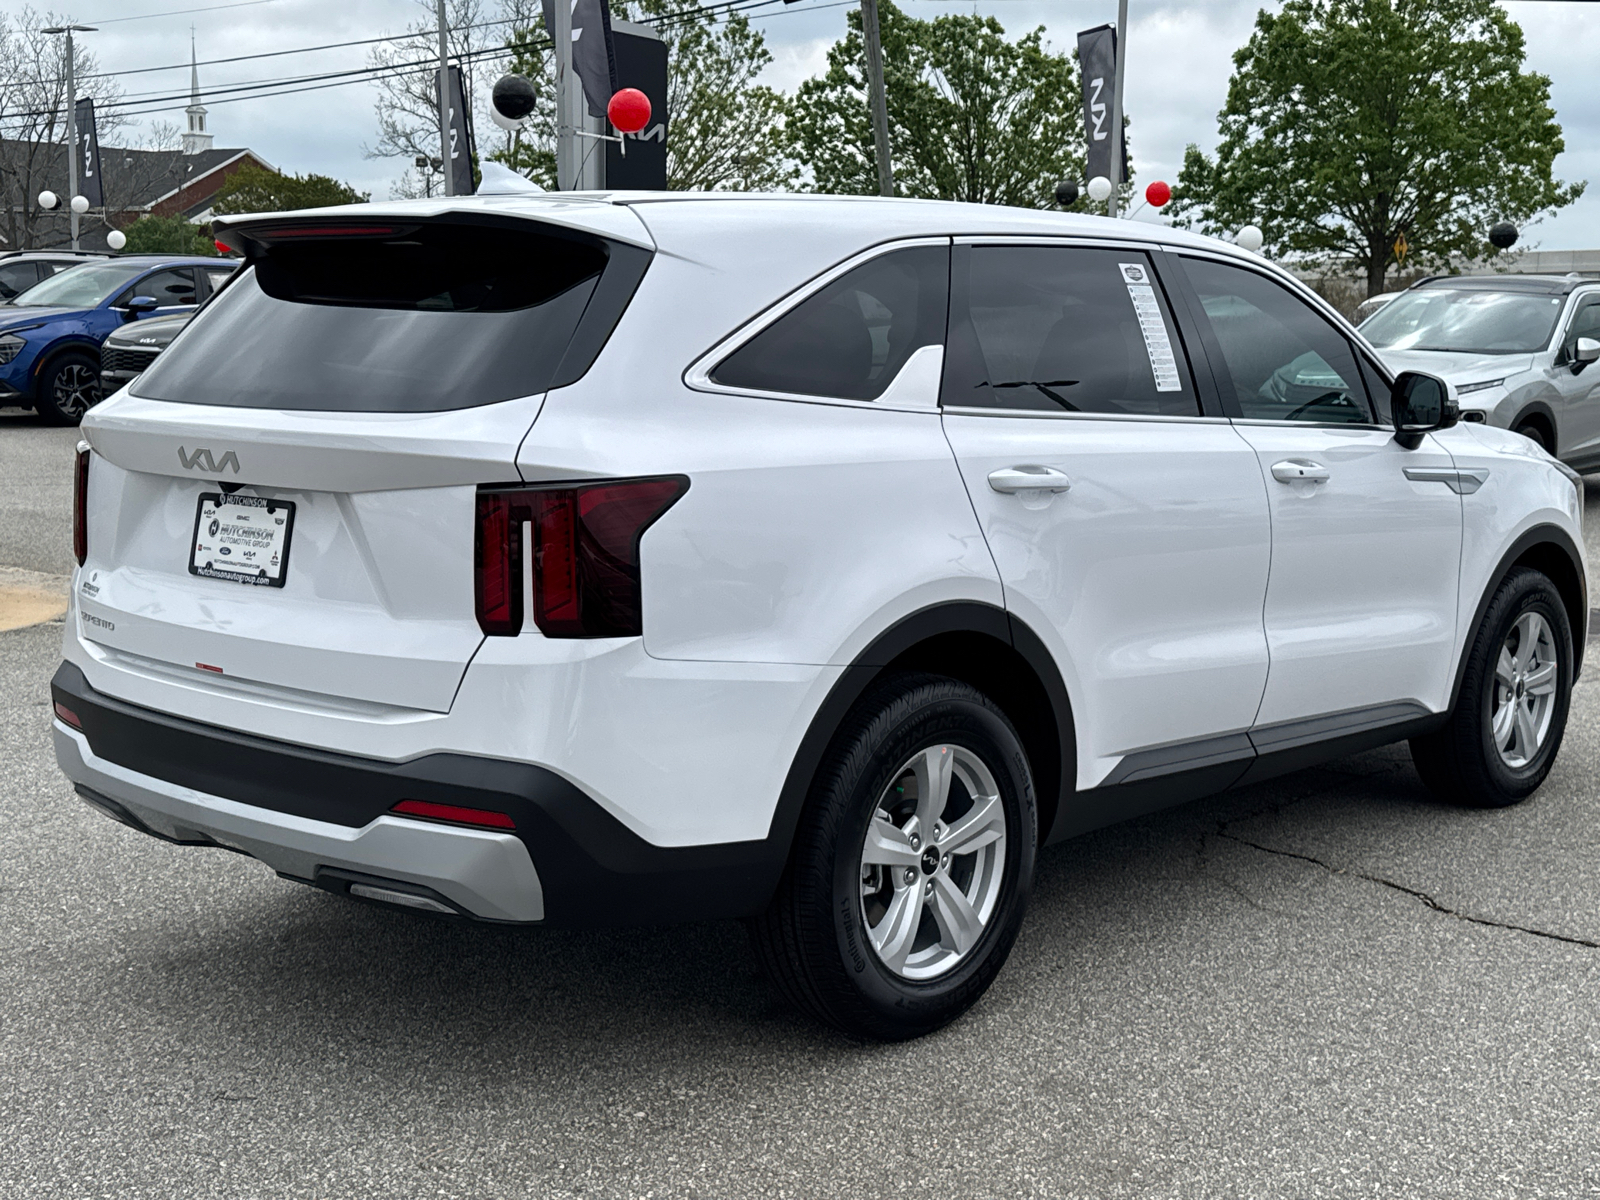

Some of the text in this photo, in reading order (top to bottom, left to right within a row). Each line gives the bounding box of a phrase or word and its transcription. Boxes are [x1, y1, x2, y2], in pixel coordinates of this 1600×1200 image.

[177, 445, 241, 474] KIA
[227, 495, 268, 508] HUTCHINSON
[220, 537, 251, 546] AUTOMOTIVE
[197, 567, 269, 584] Hutchinsonautogroup.com
